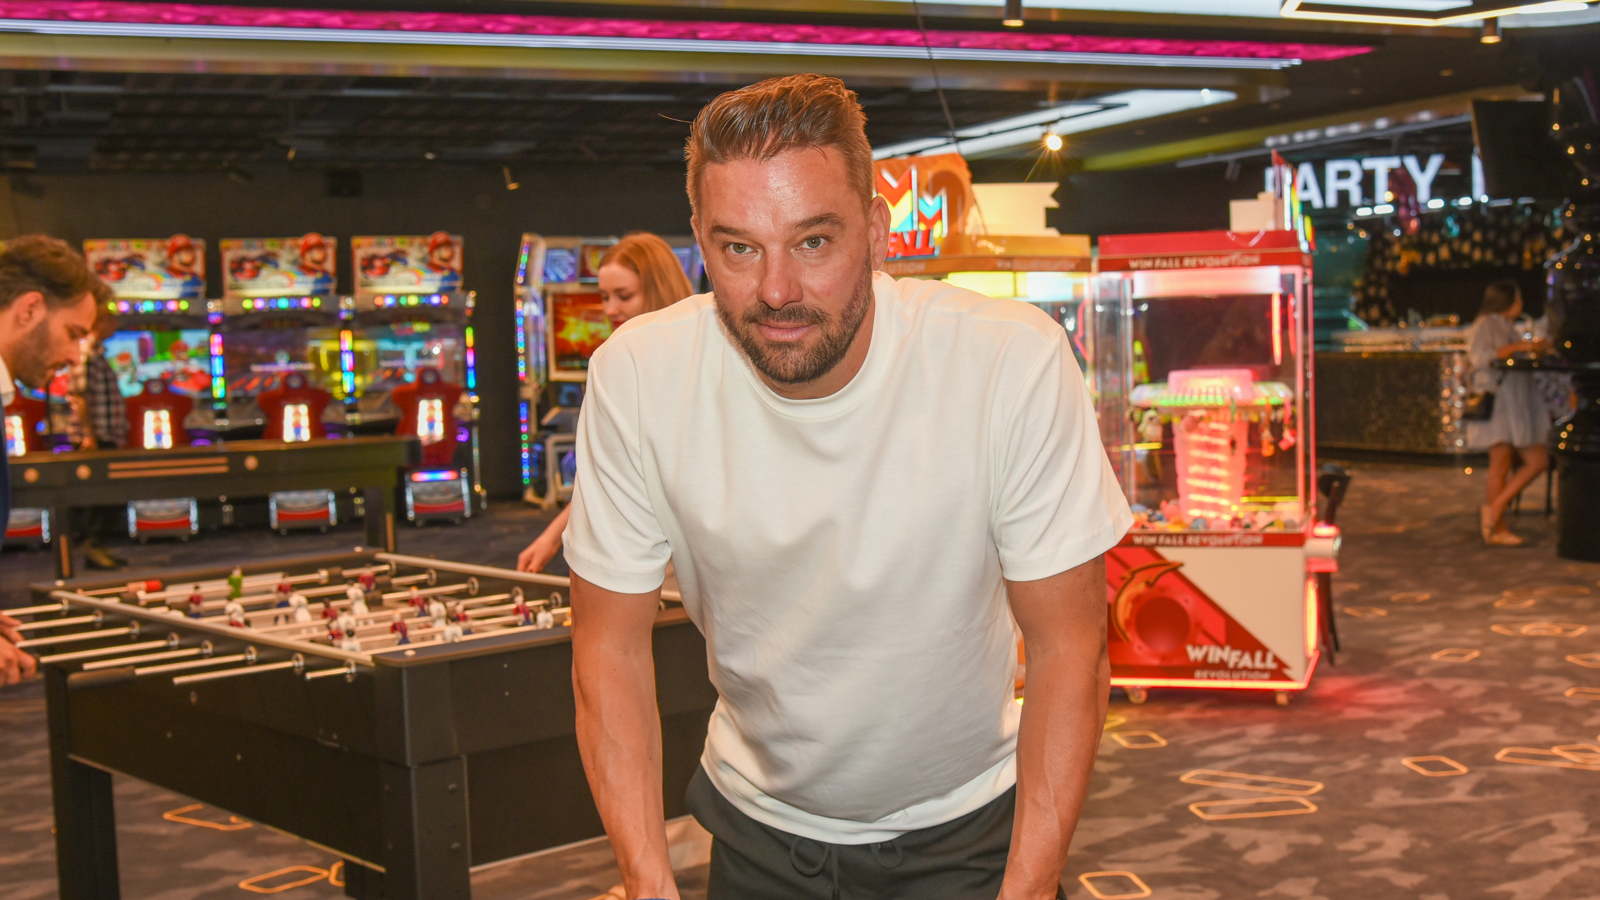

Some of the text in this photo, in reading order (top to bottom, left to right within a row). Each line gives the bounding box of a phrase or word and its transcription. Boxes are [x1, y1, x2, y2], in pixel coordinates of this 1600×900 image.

[1128, 254, 1261, 270] WIN FALL REVOLUTION
[1132, 533, 1263, 546] WIN FALL REVOLUTION
[1185, 643, 1278, 670] WINFALL
[1193, 669, 1271, 680] REVOLUTION
